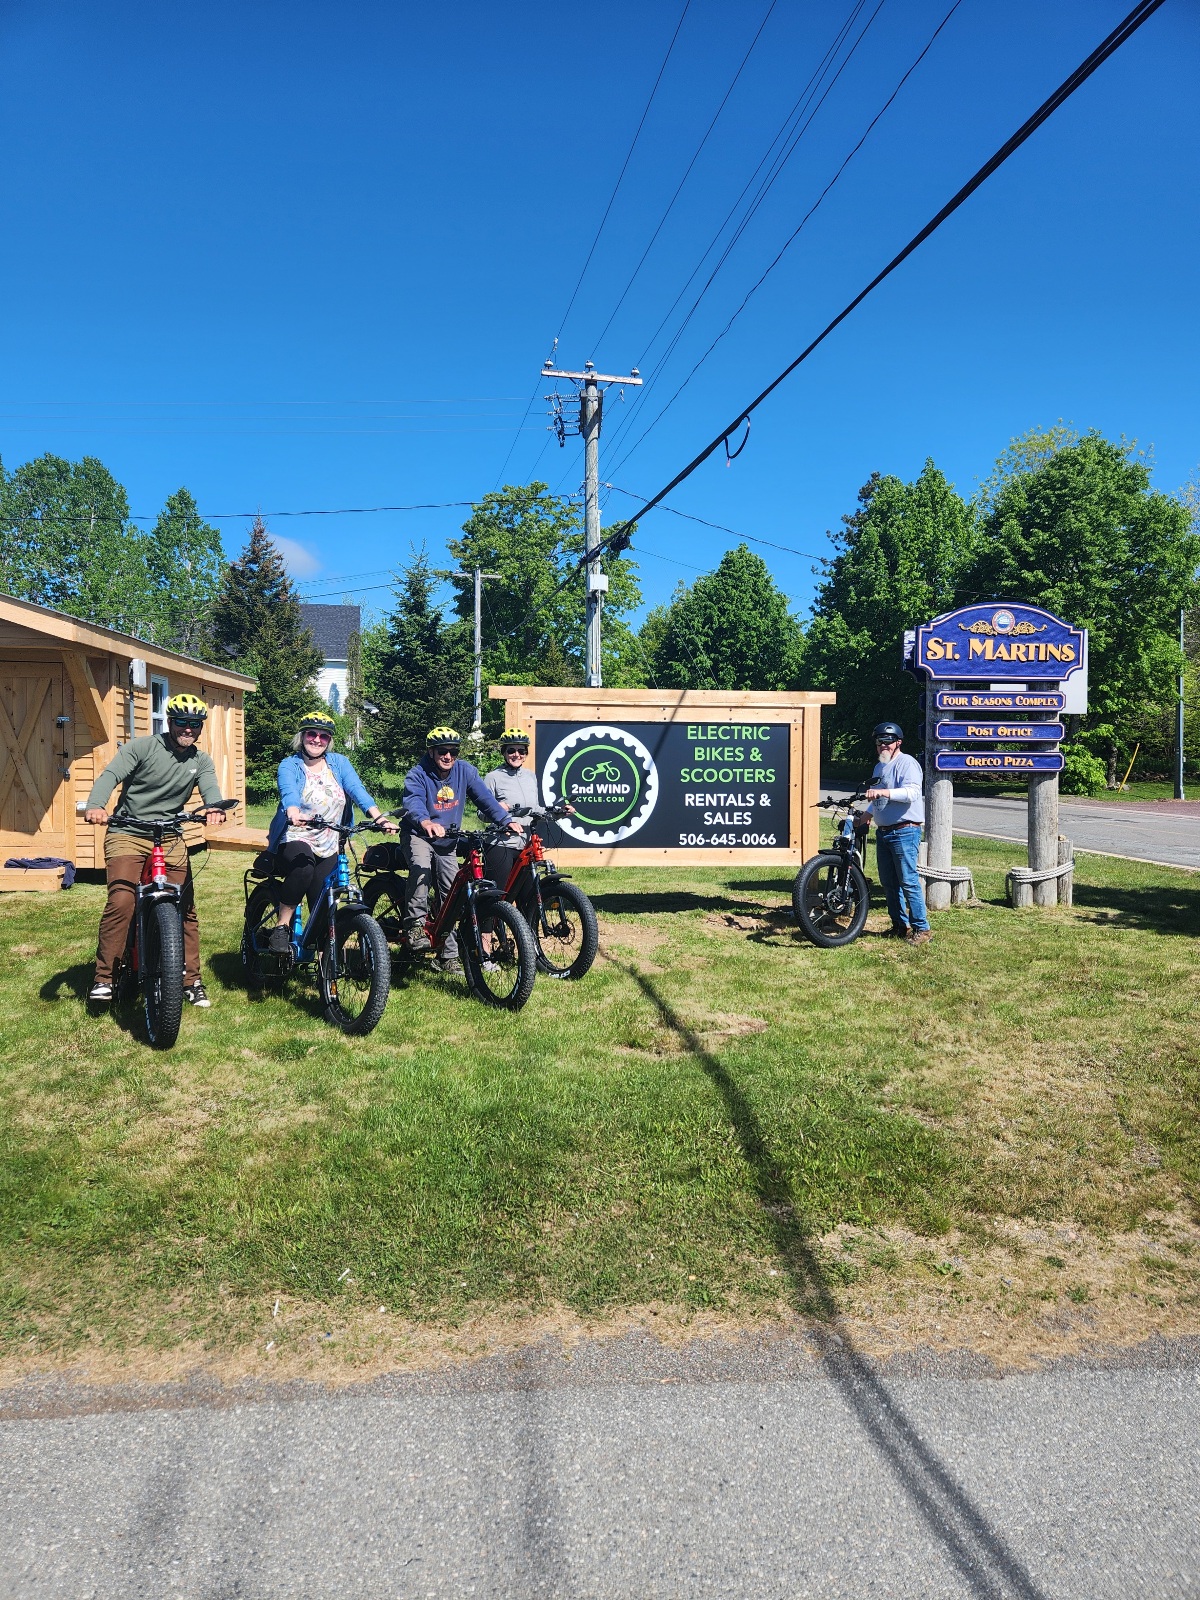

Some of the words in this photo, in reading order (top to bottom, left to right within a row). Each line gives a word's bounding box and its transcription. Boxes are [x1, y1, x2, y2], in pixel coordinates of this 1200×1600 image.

[926, 637, 961, 660] ST.
[968, 638, 1076, 662] MARTINS
[943, 695, 968, 706] FOUR
[971, 695, 1013, 706] SEASONS
[1015, 695, 1059, 706] COMPLEX
[687, 725, 771, 740] ELECTRIC
[967, 725, 994, 736] POST
[997, 725, 1032, 737] OFFICE
[694, 747, 745, 762] BIKES
[749, 747, 763, 762] &
[965, 755, 1002, 767] GRECO
[1003, 756, 1034, 767] PIZZA
[680, 768, 776, 783] SCOOTERS
[571, 783, 594, 794] 2nd
[595, 783, 631, 794] WIND
[684, 793, 755, 807] RENTALS
[759, 793, 772, 807] &
[703, 811, 752, 825] SALES
[678, 833, 777, 846] 506-645-0066
